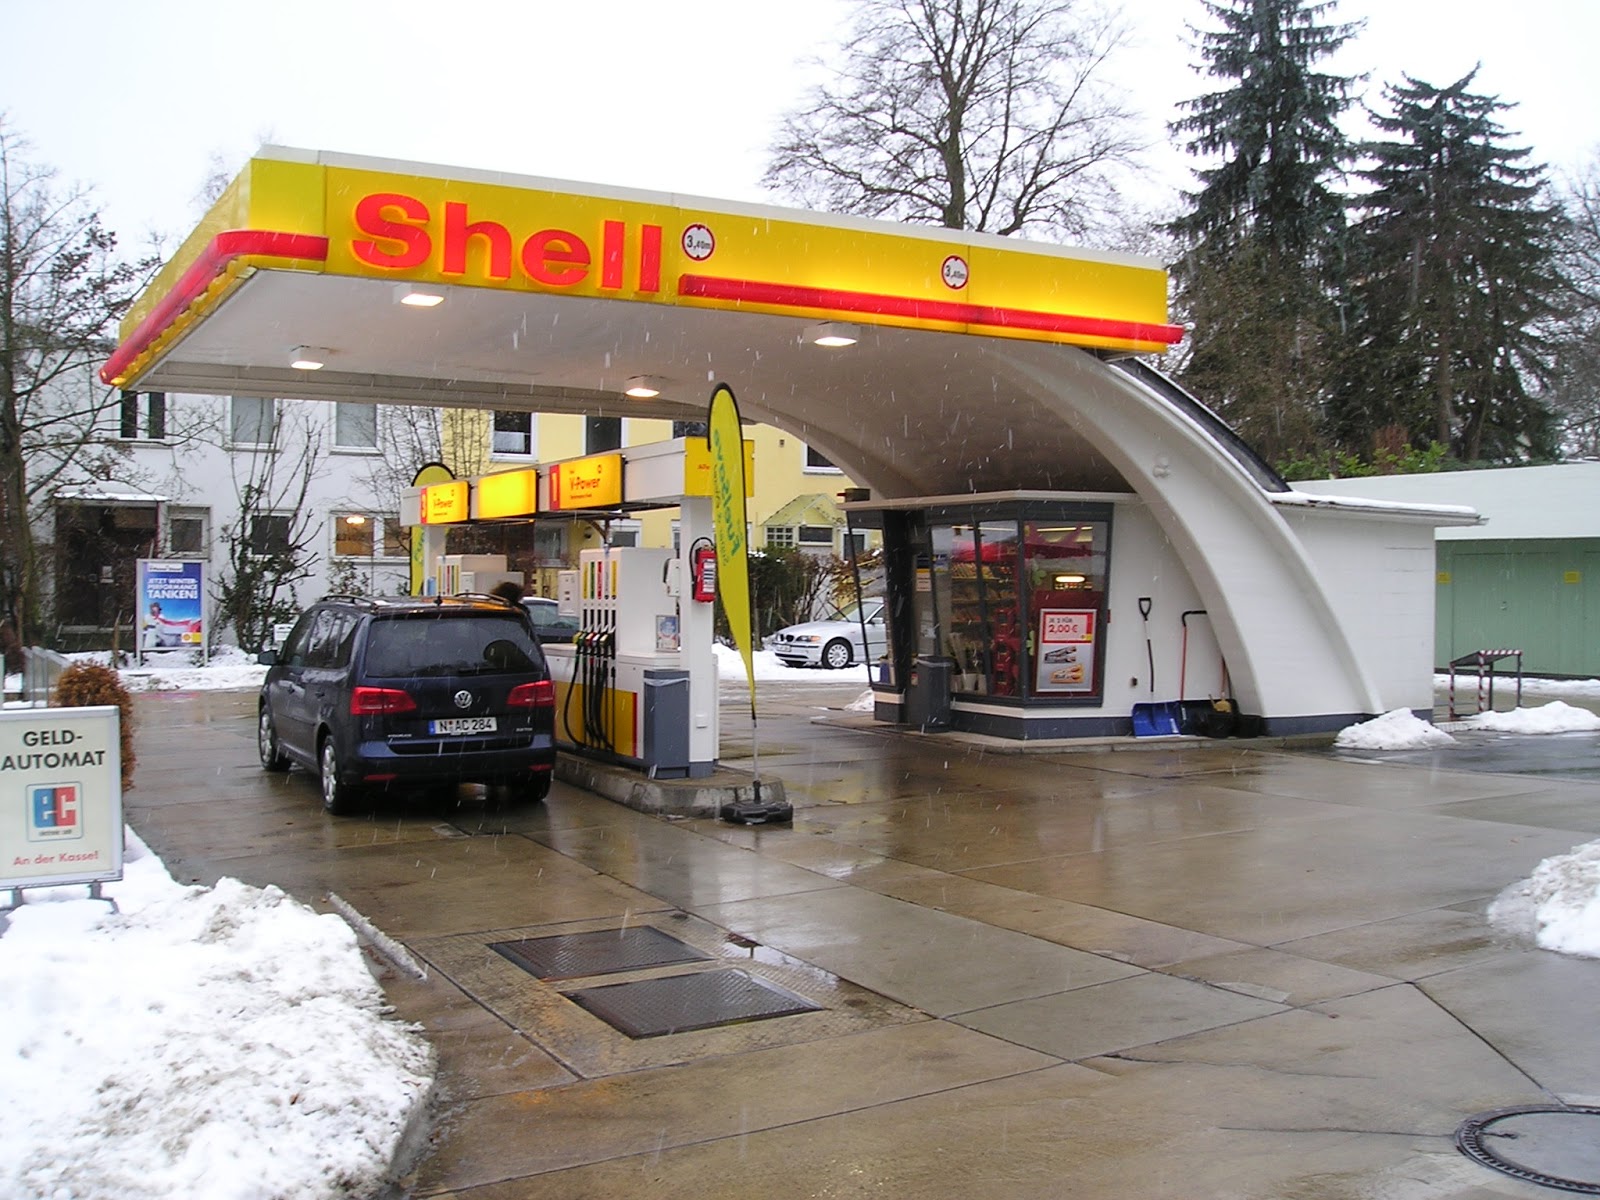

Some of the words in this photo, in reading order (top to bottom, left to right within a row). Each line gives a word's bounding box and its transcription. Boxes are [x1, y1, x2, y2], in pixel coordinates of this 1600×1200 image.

[351, 192, 662, 293] Shell
[569, 476, 601, 491] V-Power
[147, 590, 198, 599] TANKEN!
[471, 719, 492, 731] 284
[23, 730, 82, 747] GELD-
[1, 750, 105, 771] AUTOMAT
[13, 857, 30, 866] An
[34, 853, 55, 864] der
[59, 850, 99, 862] Kasse!
